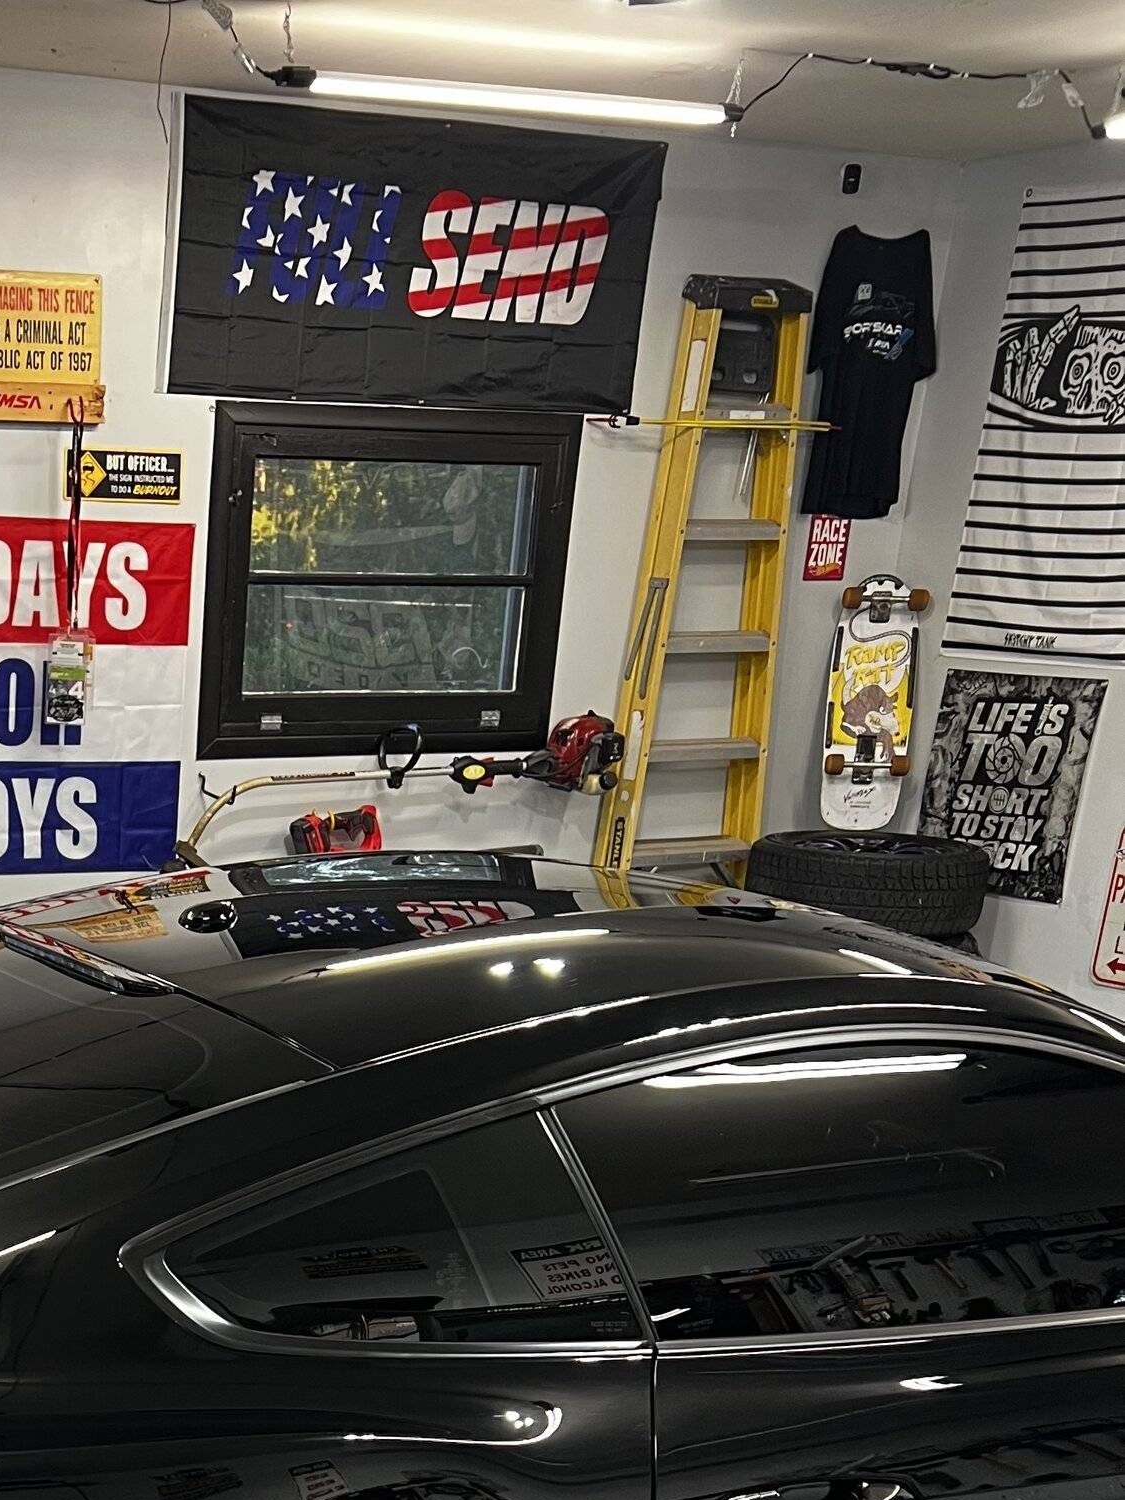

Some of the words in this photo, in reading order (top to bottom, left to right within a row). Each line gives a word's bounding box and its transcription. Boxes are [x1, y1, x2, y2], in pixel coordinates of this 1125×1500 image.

[227, 169, 402, 310] FULL
[407, 189, 610, 326] SEND
[38, 288, 59, 312] THIS
[65, 289, 95, 314] FENCE
[4, 319, 11, 343] A
[16, 319, 63, 345] CRIMINAL
[68, 322, 86, 345] ACT
[26, 351, 45, 370] ACT
[50, 352, 64, 370] OF
[69, 352, 92, 371] 1967
[106, 454, 125, 471] BUT
[108, 473, 118, 482] THE
[120, 474, 132, 482] SIGN
[134, 475, 165, 484] INSTRUCTED
[111, 485, 118, 493] TO
[119, 485, 126, 493] DO
[132, 485, 177, 496] BURNOUT
[812, 519, 848, 542] RACE
[808, 543, 845, 567] ZONE
[967, 701, 1037, 733] LIFE
[1034, 696, 1069, 737] IS
[959, 732, 1063, 787] TOO
[952, 783, 1049, 816] SHORT
[949, 812, 981, 837] TO
[980, 815, 1044, 843] STAY
